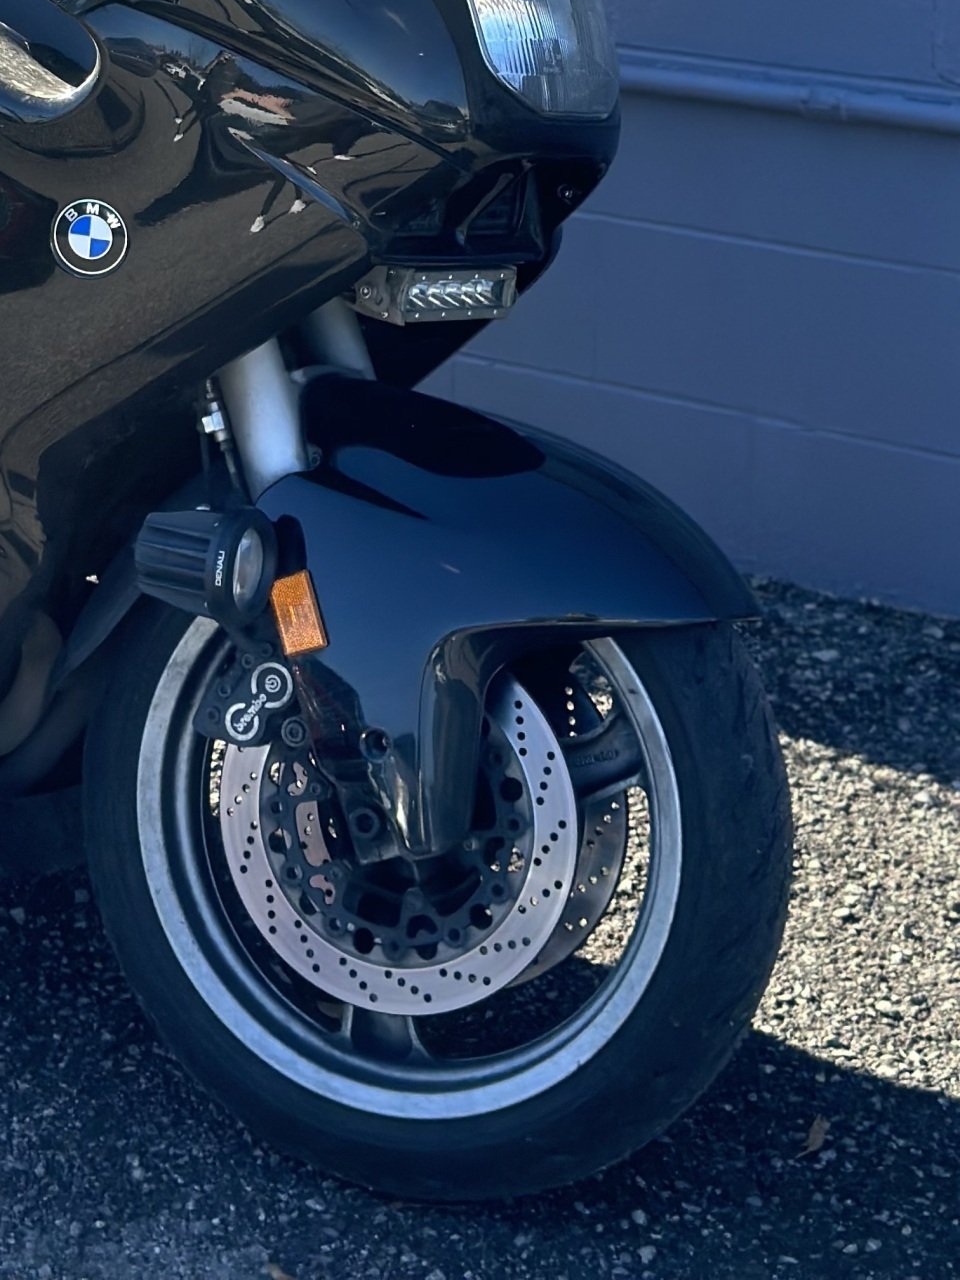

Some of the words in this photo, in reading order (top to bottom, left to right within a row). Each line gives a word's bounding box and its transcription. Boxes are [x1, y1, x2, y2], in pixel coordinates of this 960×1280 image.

[64, 202, 121, 229] BMW
[214, 551, 225, 586] DENALI
[233, 693, 267, 731] brembo
